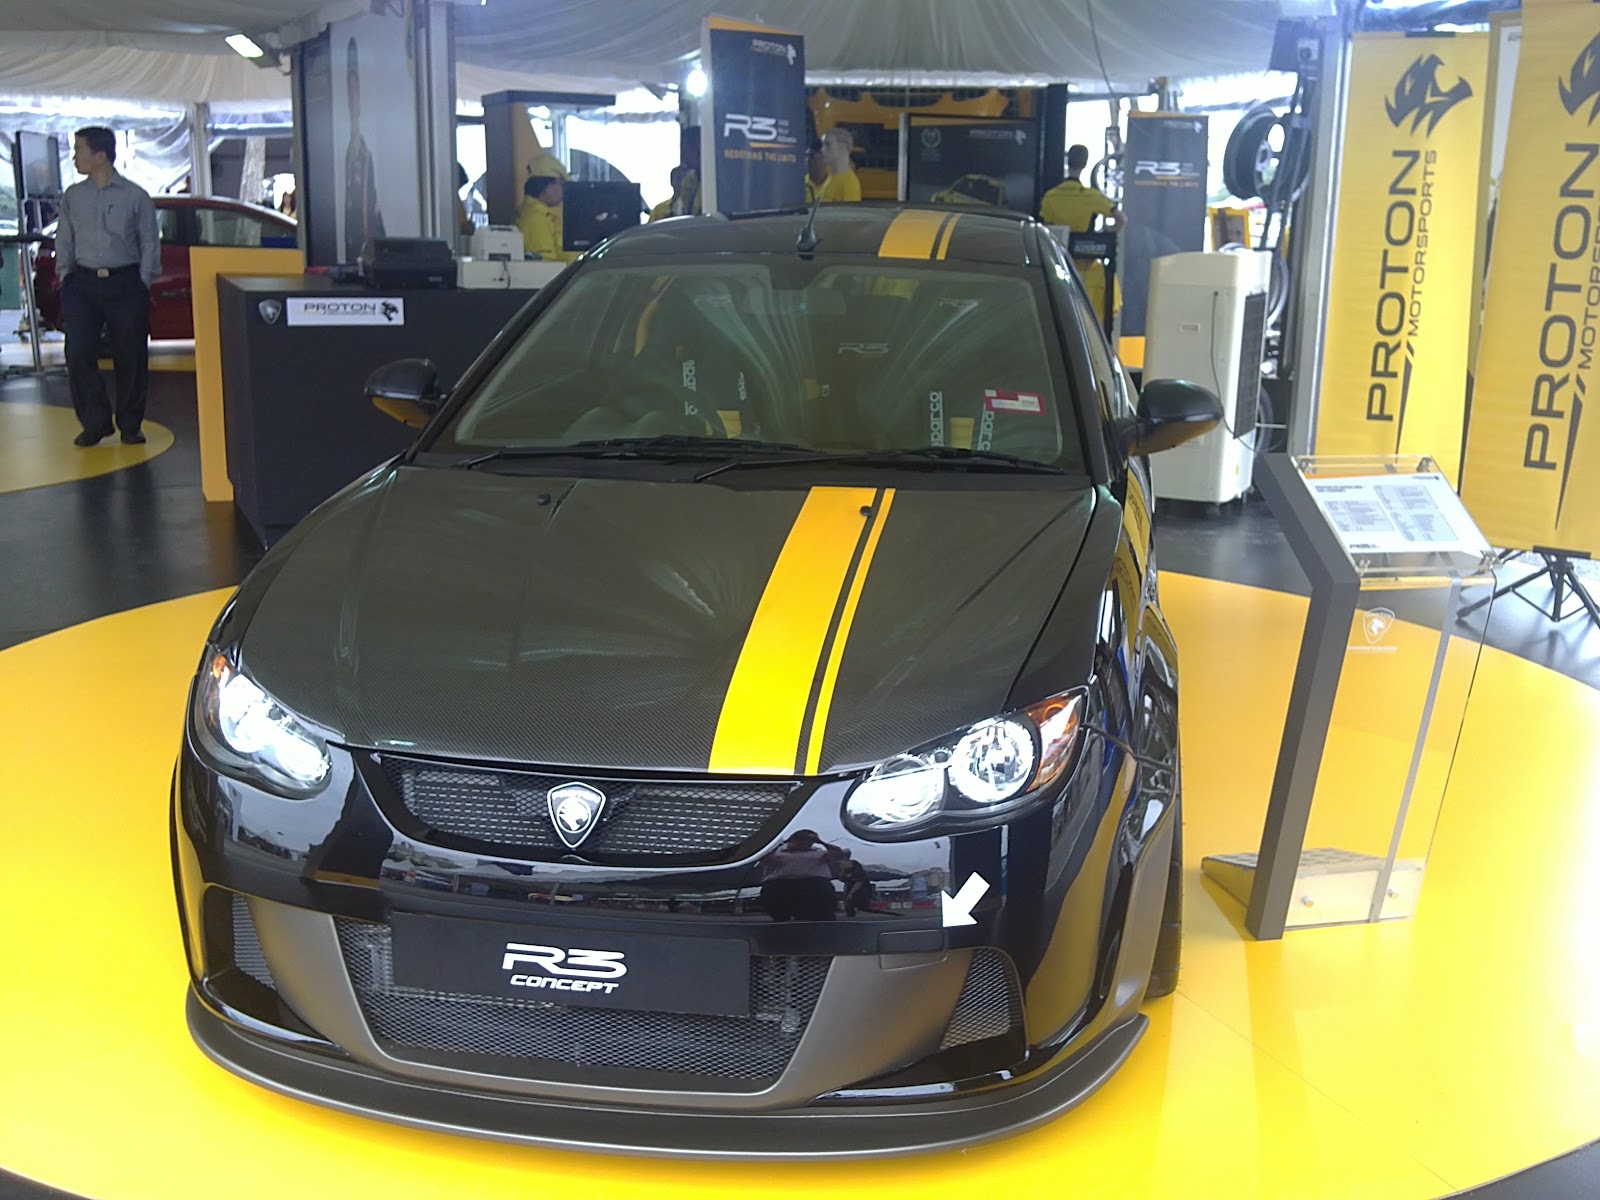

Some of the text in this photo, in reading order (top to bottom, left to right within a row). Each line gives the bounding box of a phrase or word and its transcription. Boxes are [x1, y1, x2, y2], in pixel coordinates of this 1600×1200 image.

[724, 113, 777, 140] R3
[1135, 160, 1181, 175] R3
[1408, 149, 1437, 337] MOTORSPORTS
[1366, 149, 1421, 421] PROTON
[304, 302, 377, 312] PROTON
[1523, 142, 1600, 471] PROTON
[502, 943, 627, 978] R3
[510, 974, 619, 994] CONCEPT
